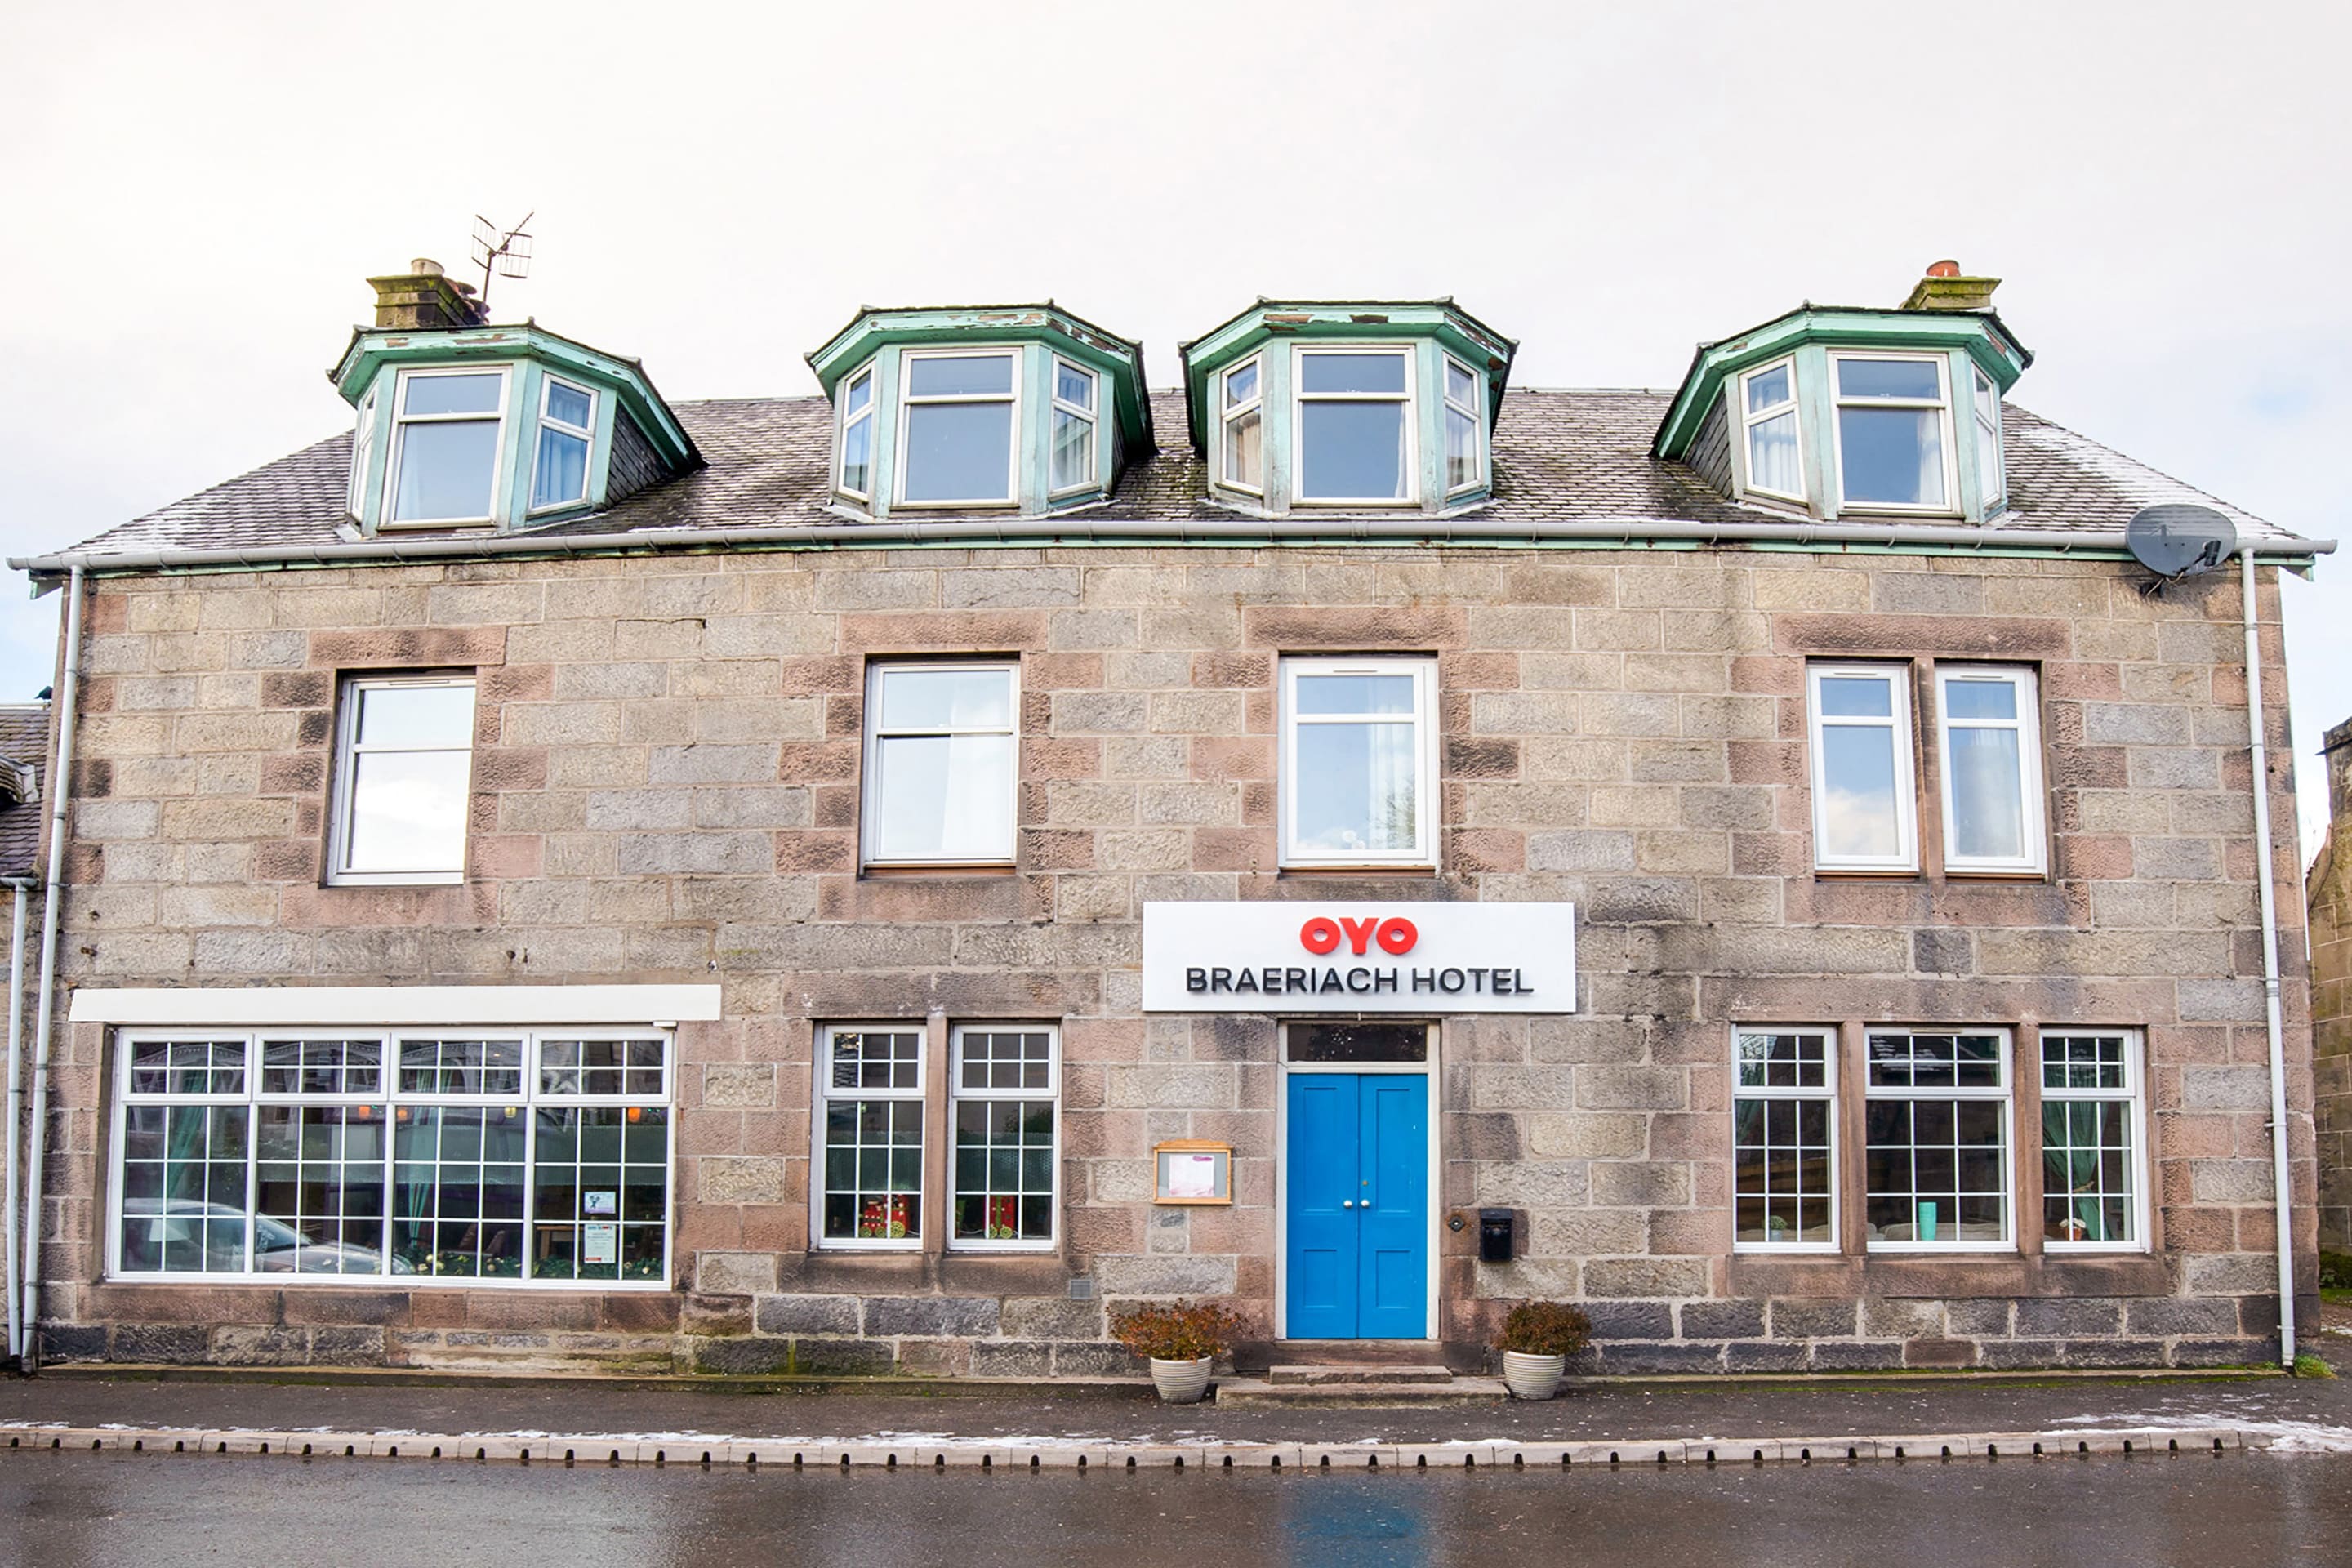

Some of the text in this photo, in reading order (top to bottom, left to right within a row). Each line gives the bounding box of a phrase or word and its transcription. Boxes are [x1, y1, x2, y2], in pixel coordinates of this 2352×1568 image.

[1300, 917, 1419, 955] OYO
[1186, 967, 1535, 993] BRAERIACH HOTEL
